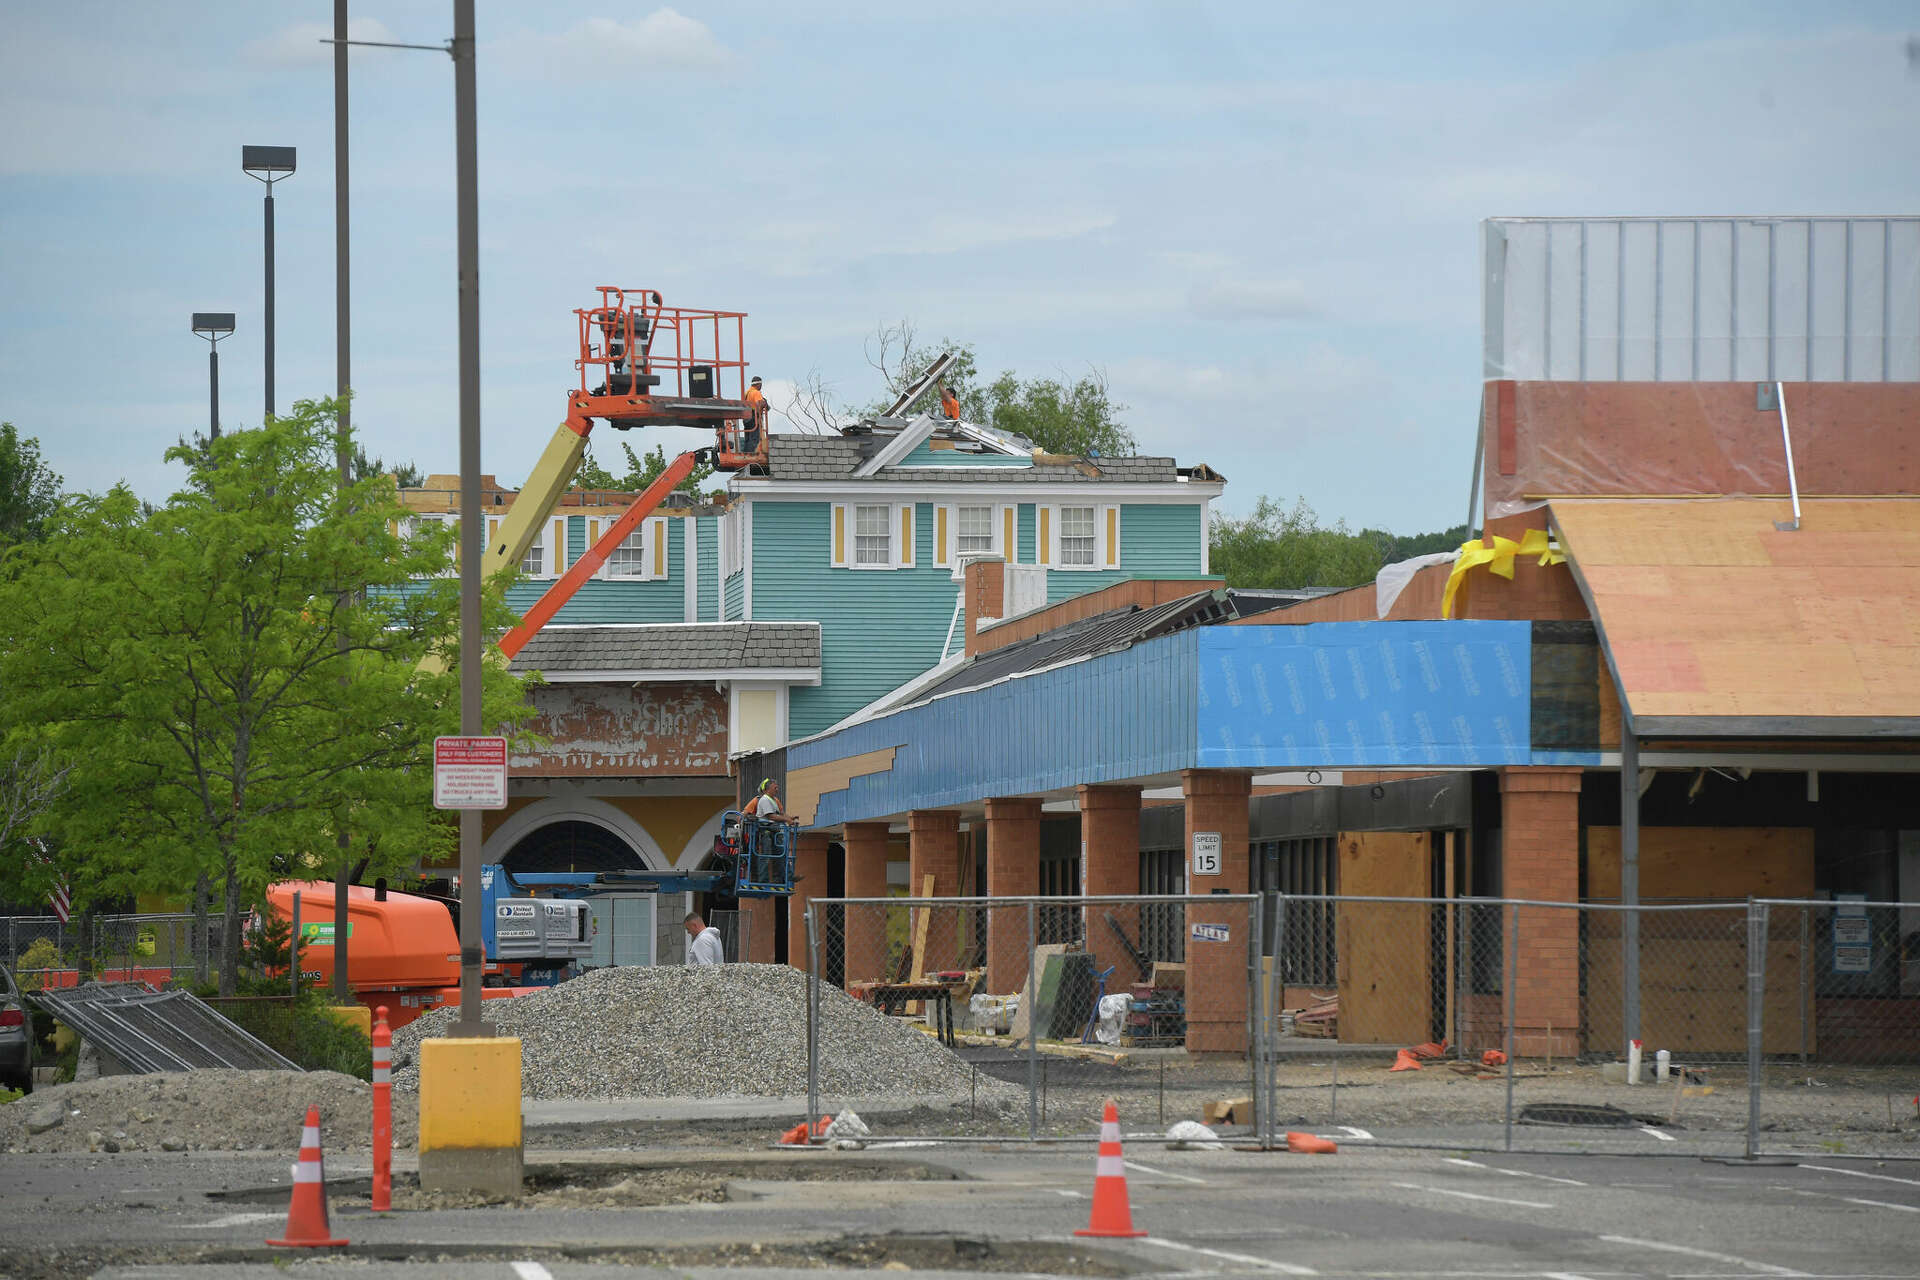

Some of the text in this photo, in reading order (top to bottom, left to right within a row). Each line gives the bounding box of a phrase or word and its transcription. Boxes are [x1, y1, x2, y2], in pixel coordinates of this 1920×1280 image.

[470, 740, 502, 748] PARKING
[1199, 856, 1216, 870] 15
[1196, 925, 1226, 940] ATLAS
